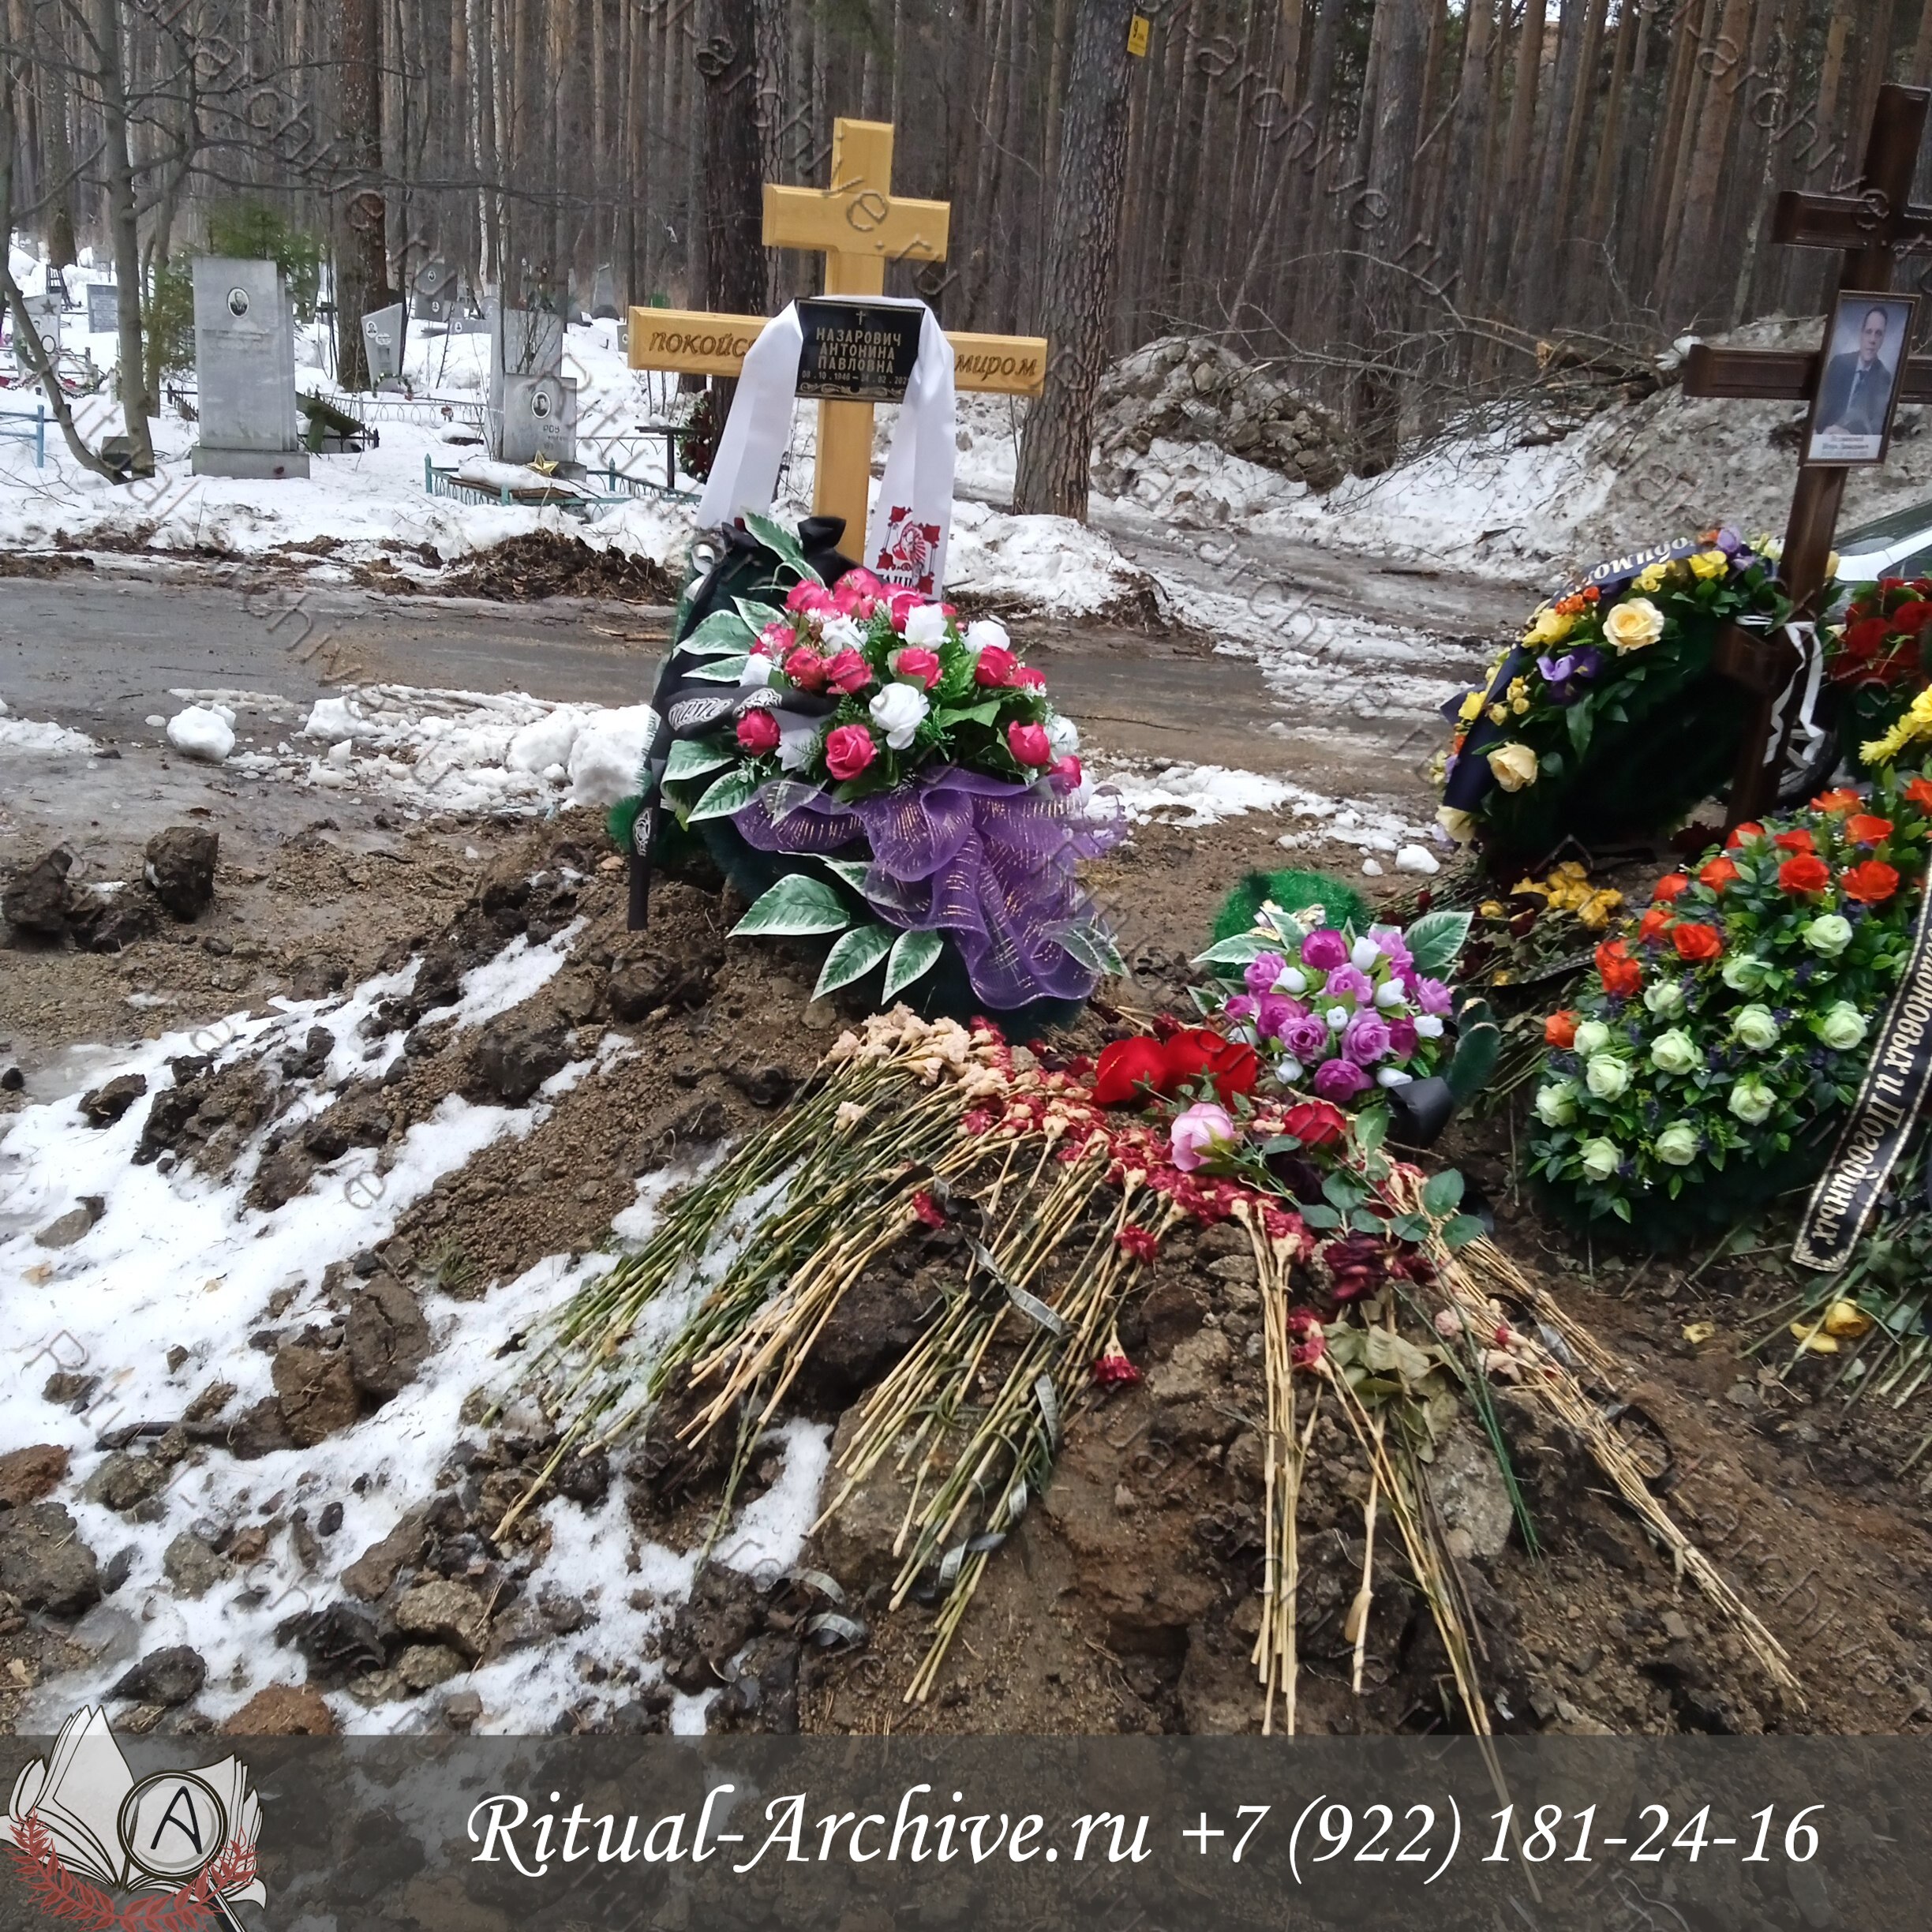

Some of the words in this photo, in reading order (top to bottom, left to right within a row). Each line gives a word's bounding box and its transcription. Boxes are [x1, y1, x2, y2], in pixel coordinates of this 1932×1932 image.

[816, 327, 901, 346] НАЗАРОВИЧ
[649, 331, 756, 358] покойс
[955, 354, 1038, 382] миром
[820, 342, 895, 360] АНТОНИНА
[818, 356, 894, 374] ПАВЛОВНА
[1874, 1073, 1906, 1097] и
[1810, 1092, 1906, 1246] Погодиных
